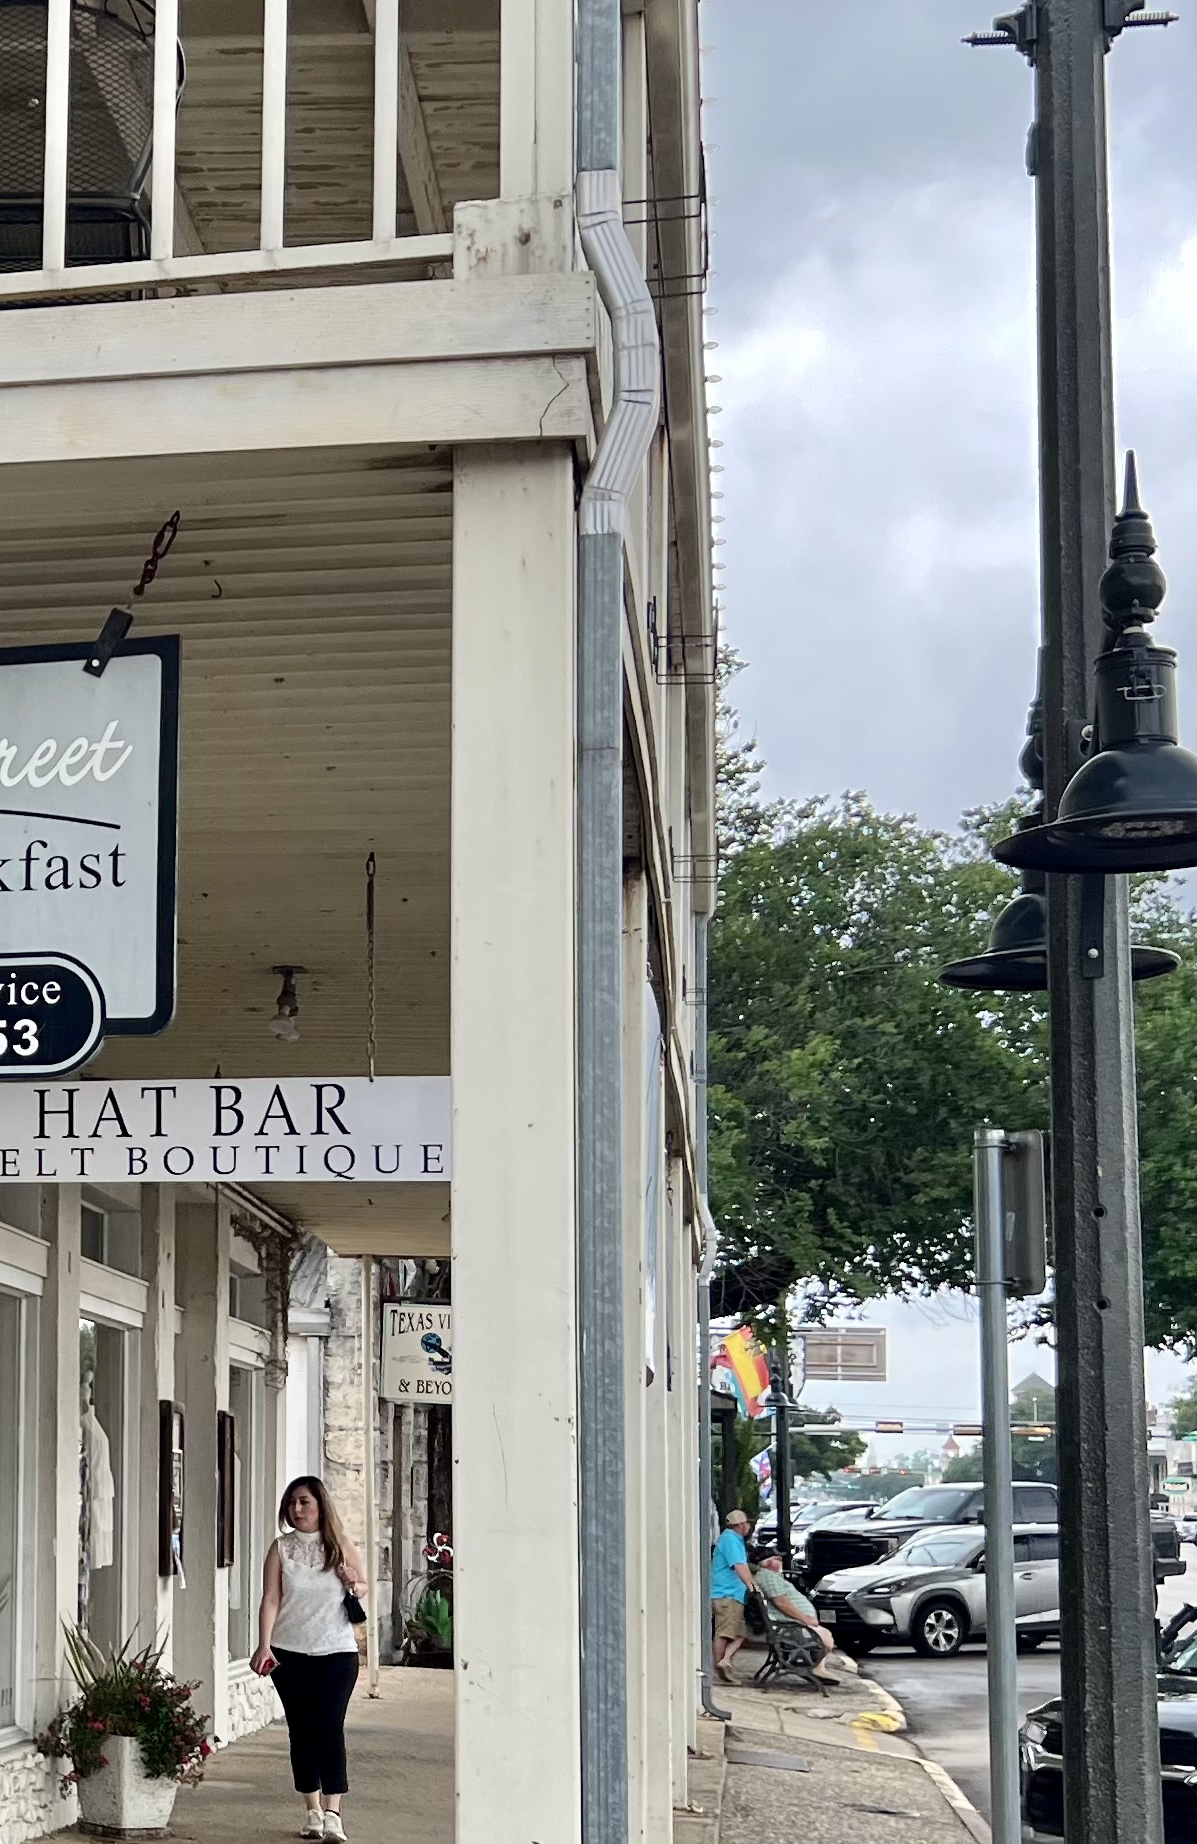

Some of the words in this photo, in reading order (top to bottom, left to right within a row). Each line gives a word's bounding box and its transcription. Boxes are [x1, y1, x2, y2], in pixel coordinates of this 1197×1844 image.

[33, 1085, 177, 1139] HAT
[209, 1082, 351, 1137] BAR
[126, 1143, 444, 1179] BOUTIQUE
[390, 1309, 433, 1336] TEXAS
[399, 1378, 410, 1393] &
